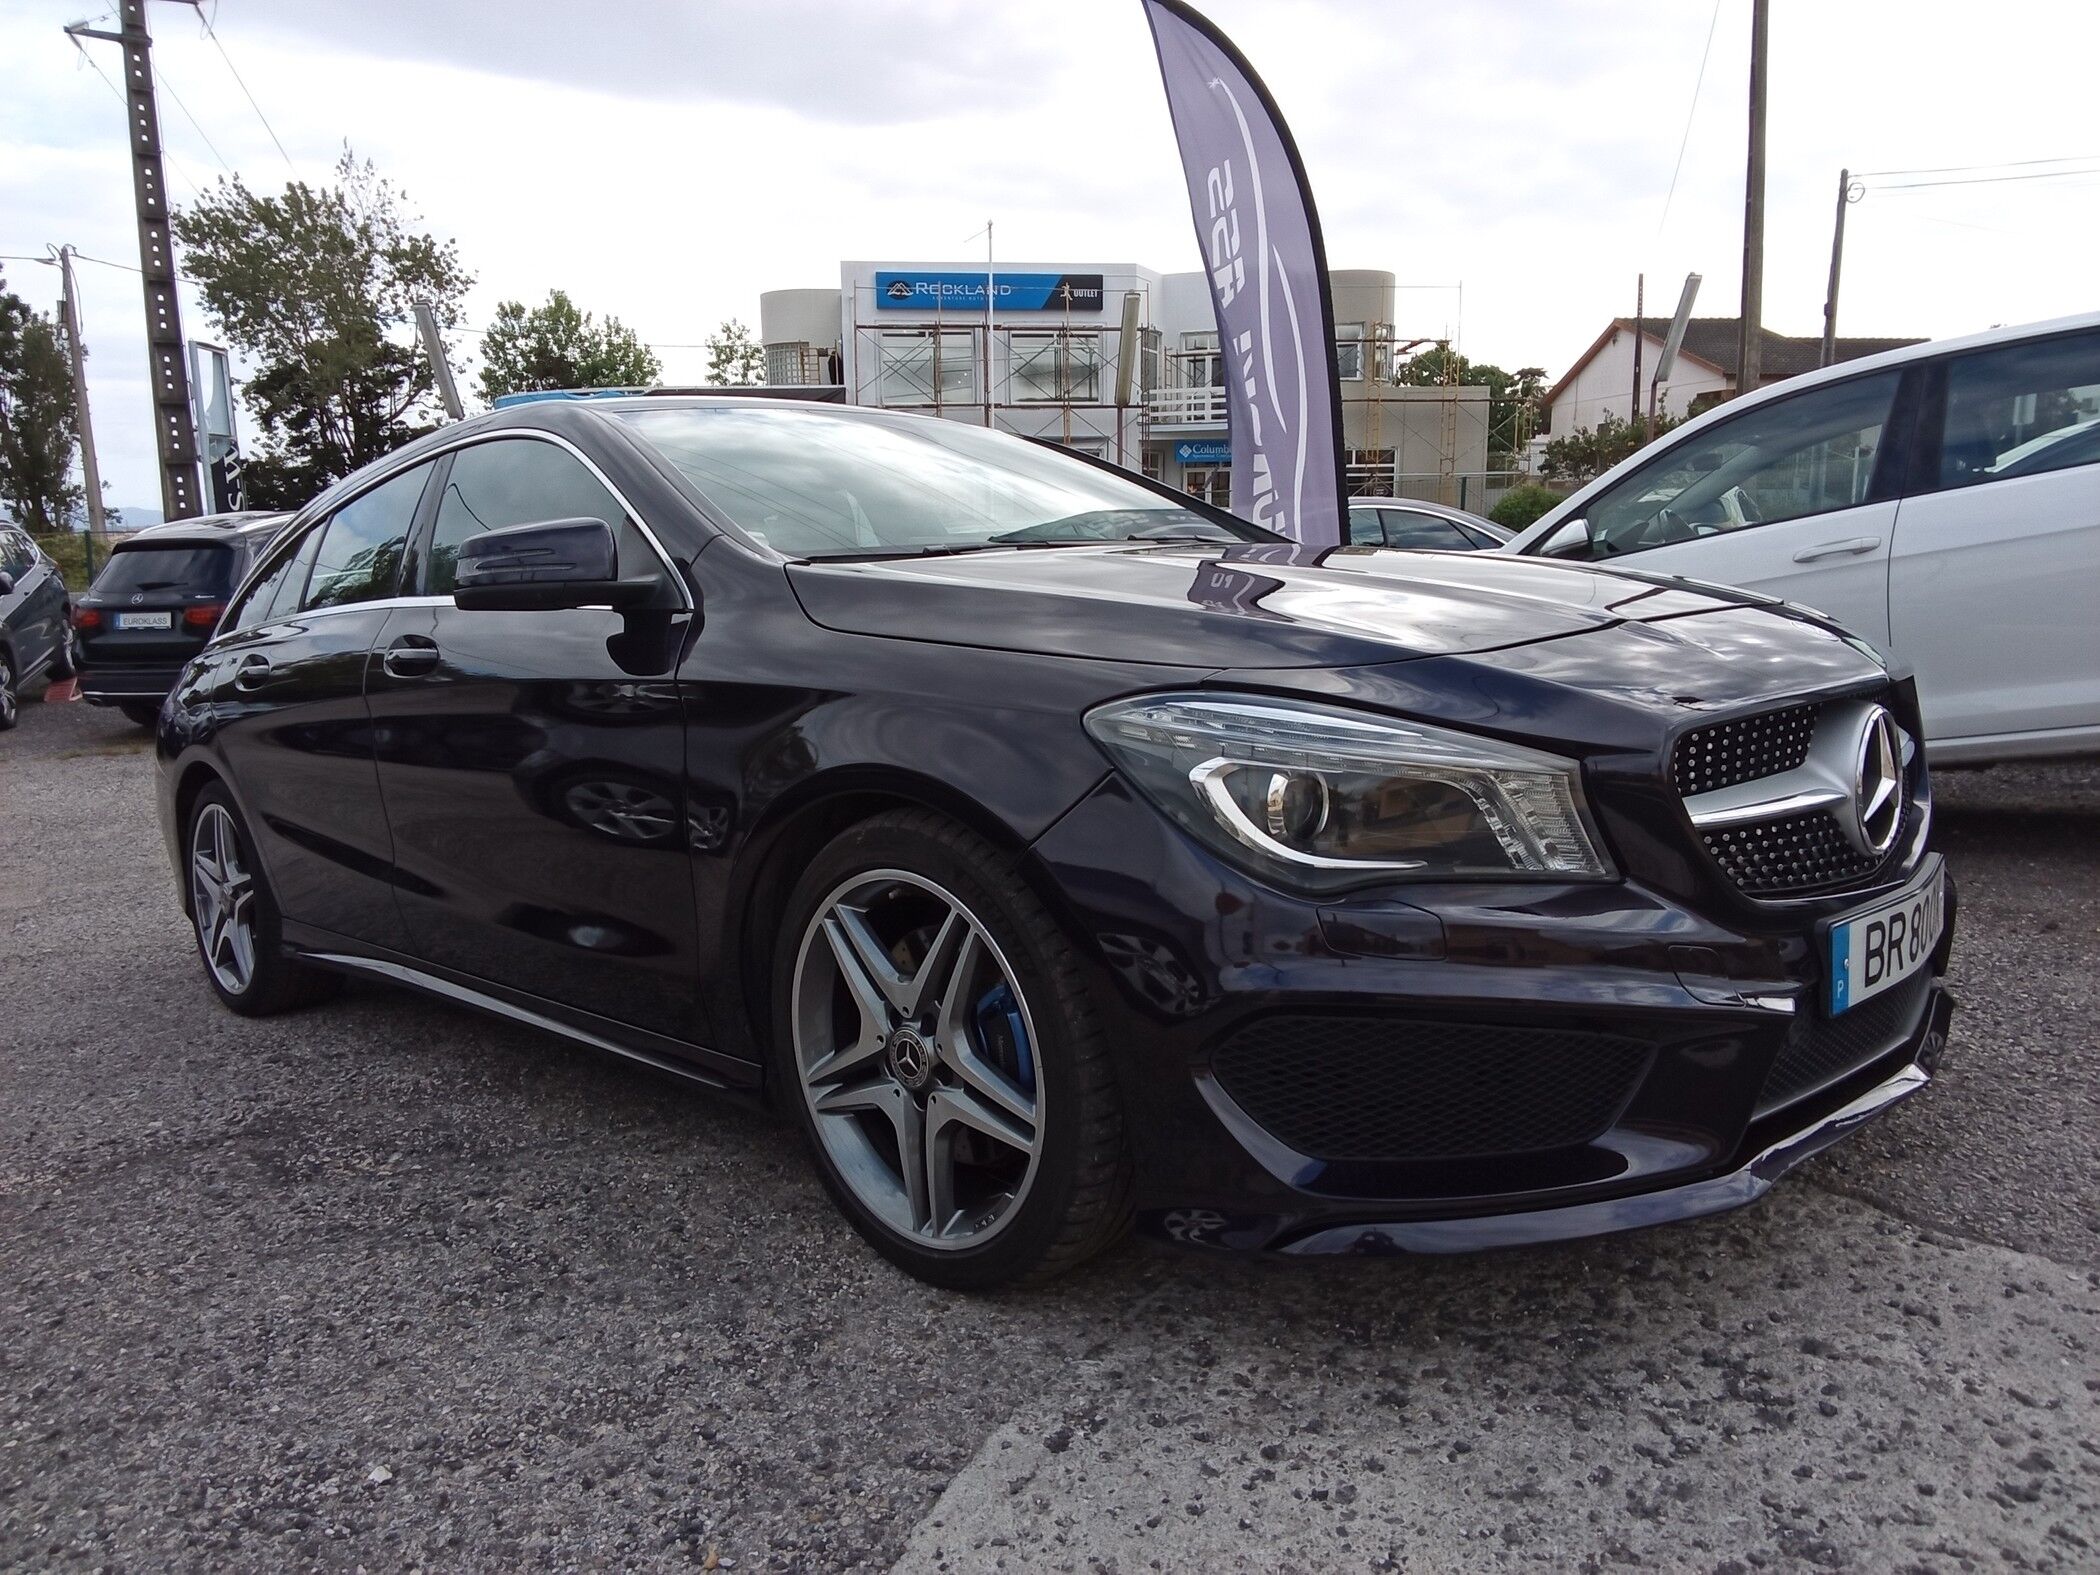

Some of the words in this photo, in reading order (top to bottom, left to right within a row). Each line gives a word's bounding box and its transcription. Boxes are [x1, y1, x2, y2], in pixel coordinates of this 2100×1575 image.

[915, 282, 1012, 296] ROCKLAND
[1073, 288, 1098, 298] OUTLET
[1192, 443, 1232, 454] Columb
[123, 617, 168, 625] EUROKLASS
[1837, 979, 1844, 999] P
